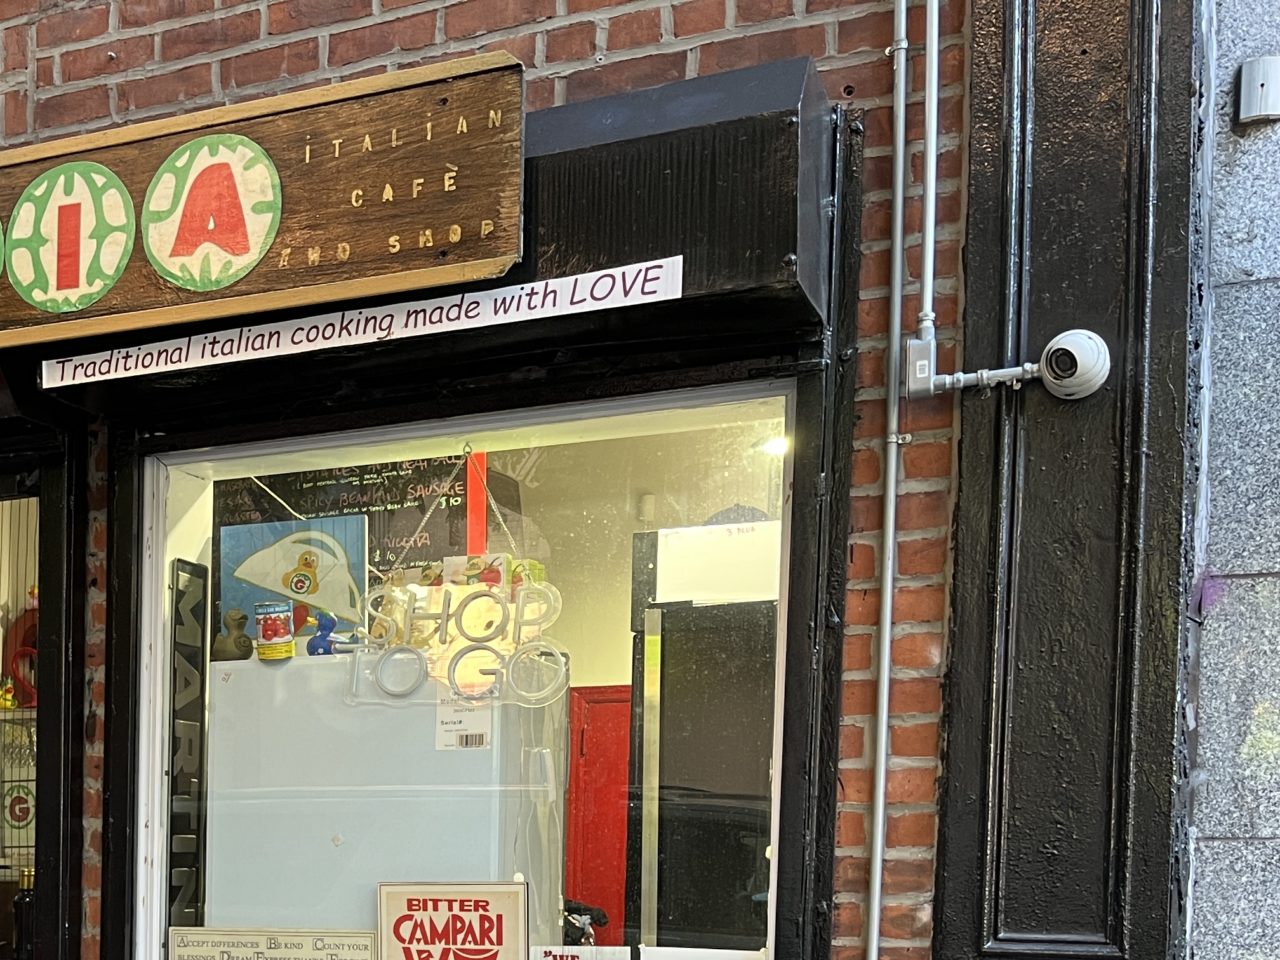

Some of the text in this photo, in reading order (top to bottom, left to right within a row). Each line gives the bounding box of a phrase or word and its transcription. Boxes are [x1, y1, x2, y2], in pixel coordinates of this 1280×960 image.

[388, 219, 495, 254] SHOP
[55, 264, 664, 382] Traditional italian cooking made with LOVE
[408, 481, 466, 500] SAUSAGE
[366, 589, 557, 646] SHOP
[448, 643, 567, 699] GO
[406, 897, 490, 913] BITTER
[177, 936, 209, 948] ACCEPT
[313, 938, 345, 950] COUNT
[393, 913, 504, 946] CAMPARI
